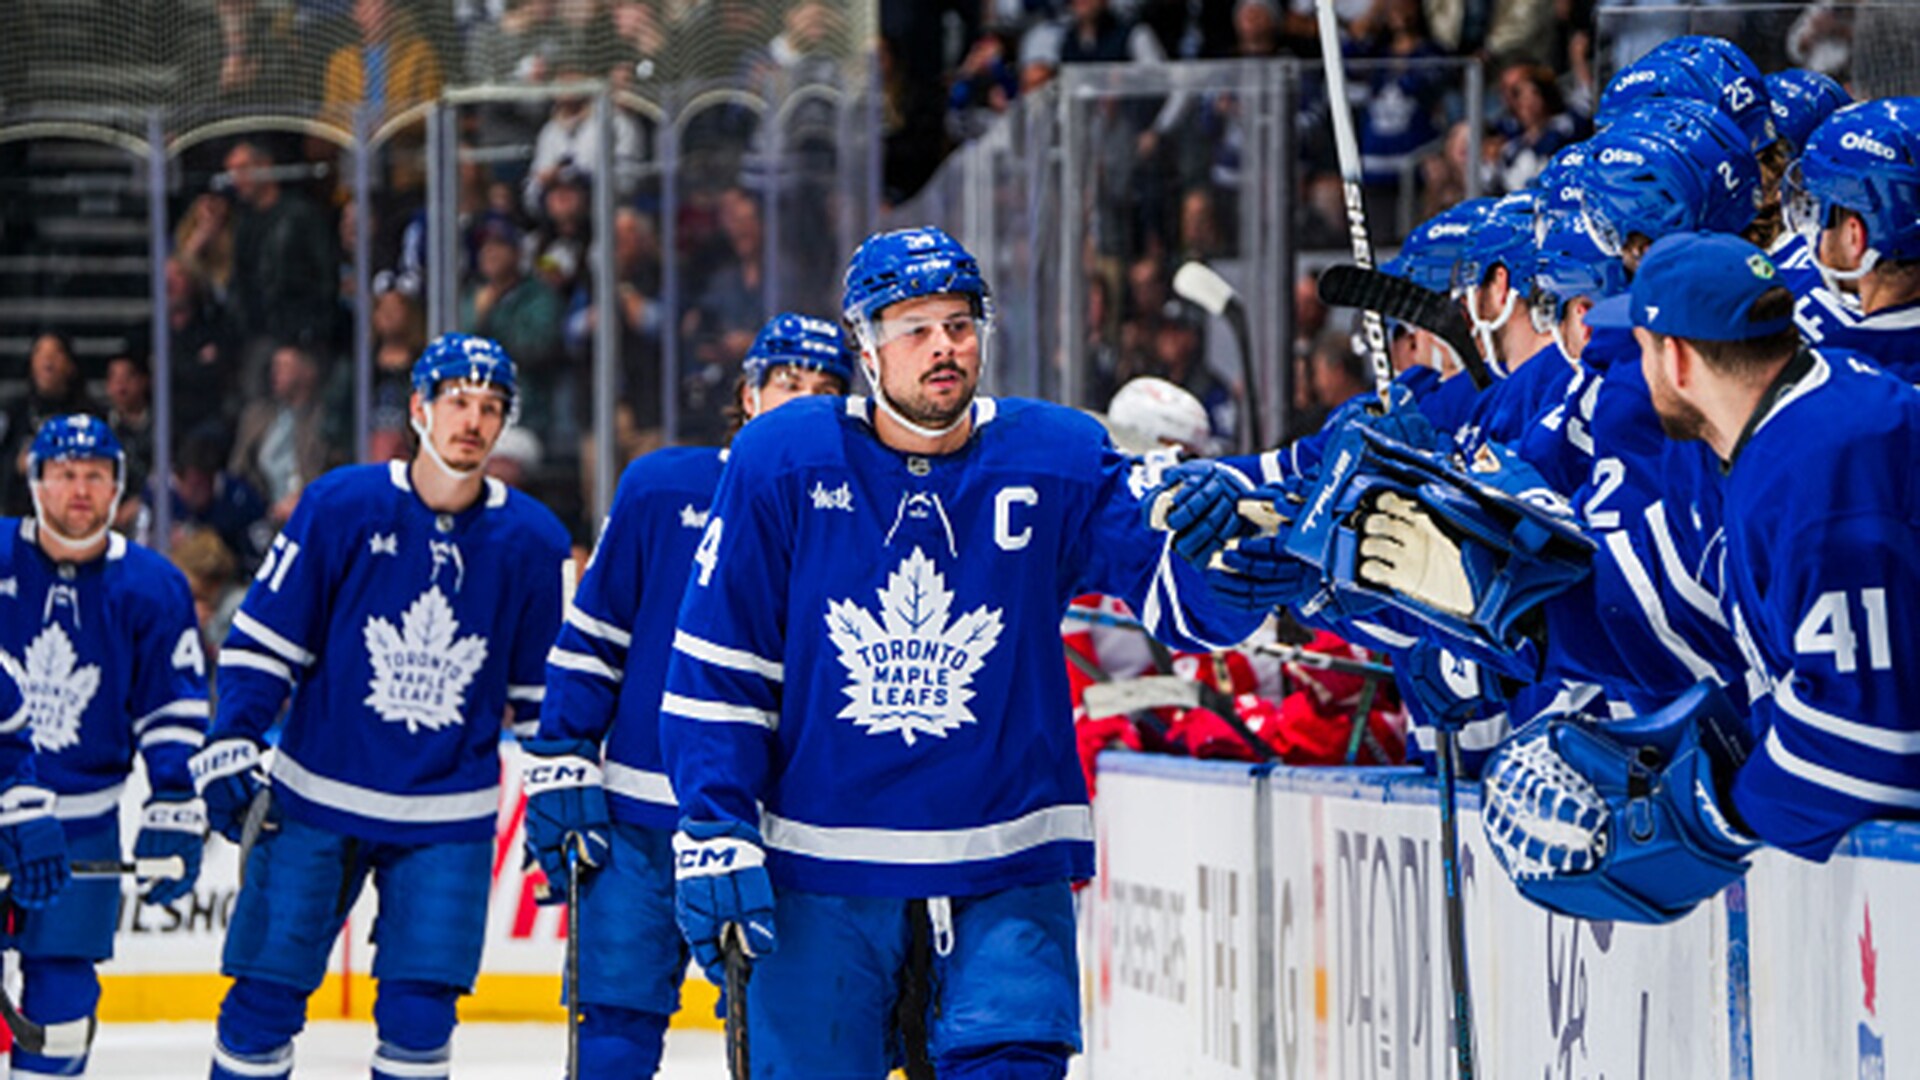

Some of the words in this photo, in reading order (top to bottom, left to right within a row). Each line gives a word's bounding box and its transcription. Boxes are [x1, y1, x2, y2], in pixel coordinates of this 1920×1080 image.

[1723, 76, 1755, 111] 25
[993, 486, 1038, 550] C
[1794, 588, 1892, 672] 41
[384, 651, 462, 681] TORONTO
[856, 639, 968, 670] TORONTO
[393, 671, 446, 690] MAPLE
[872, 666, 950, 686] MAPLE
[388, 684, 443, 706] LEAFS
[871, 687, 949, 707] LEAFS
[1197, 864, 1239, 1069] THE
